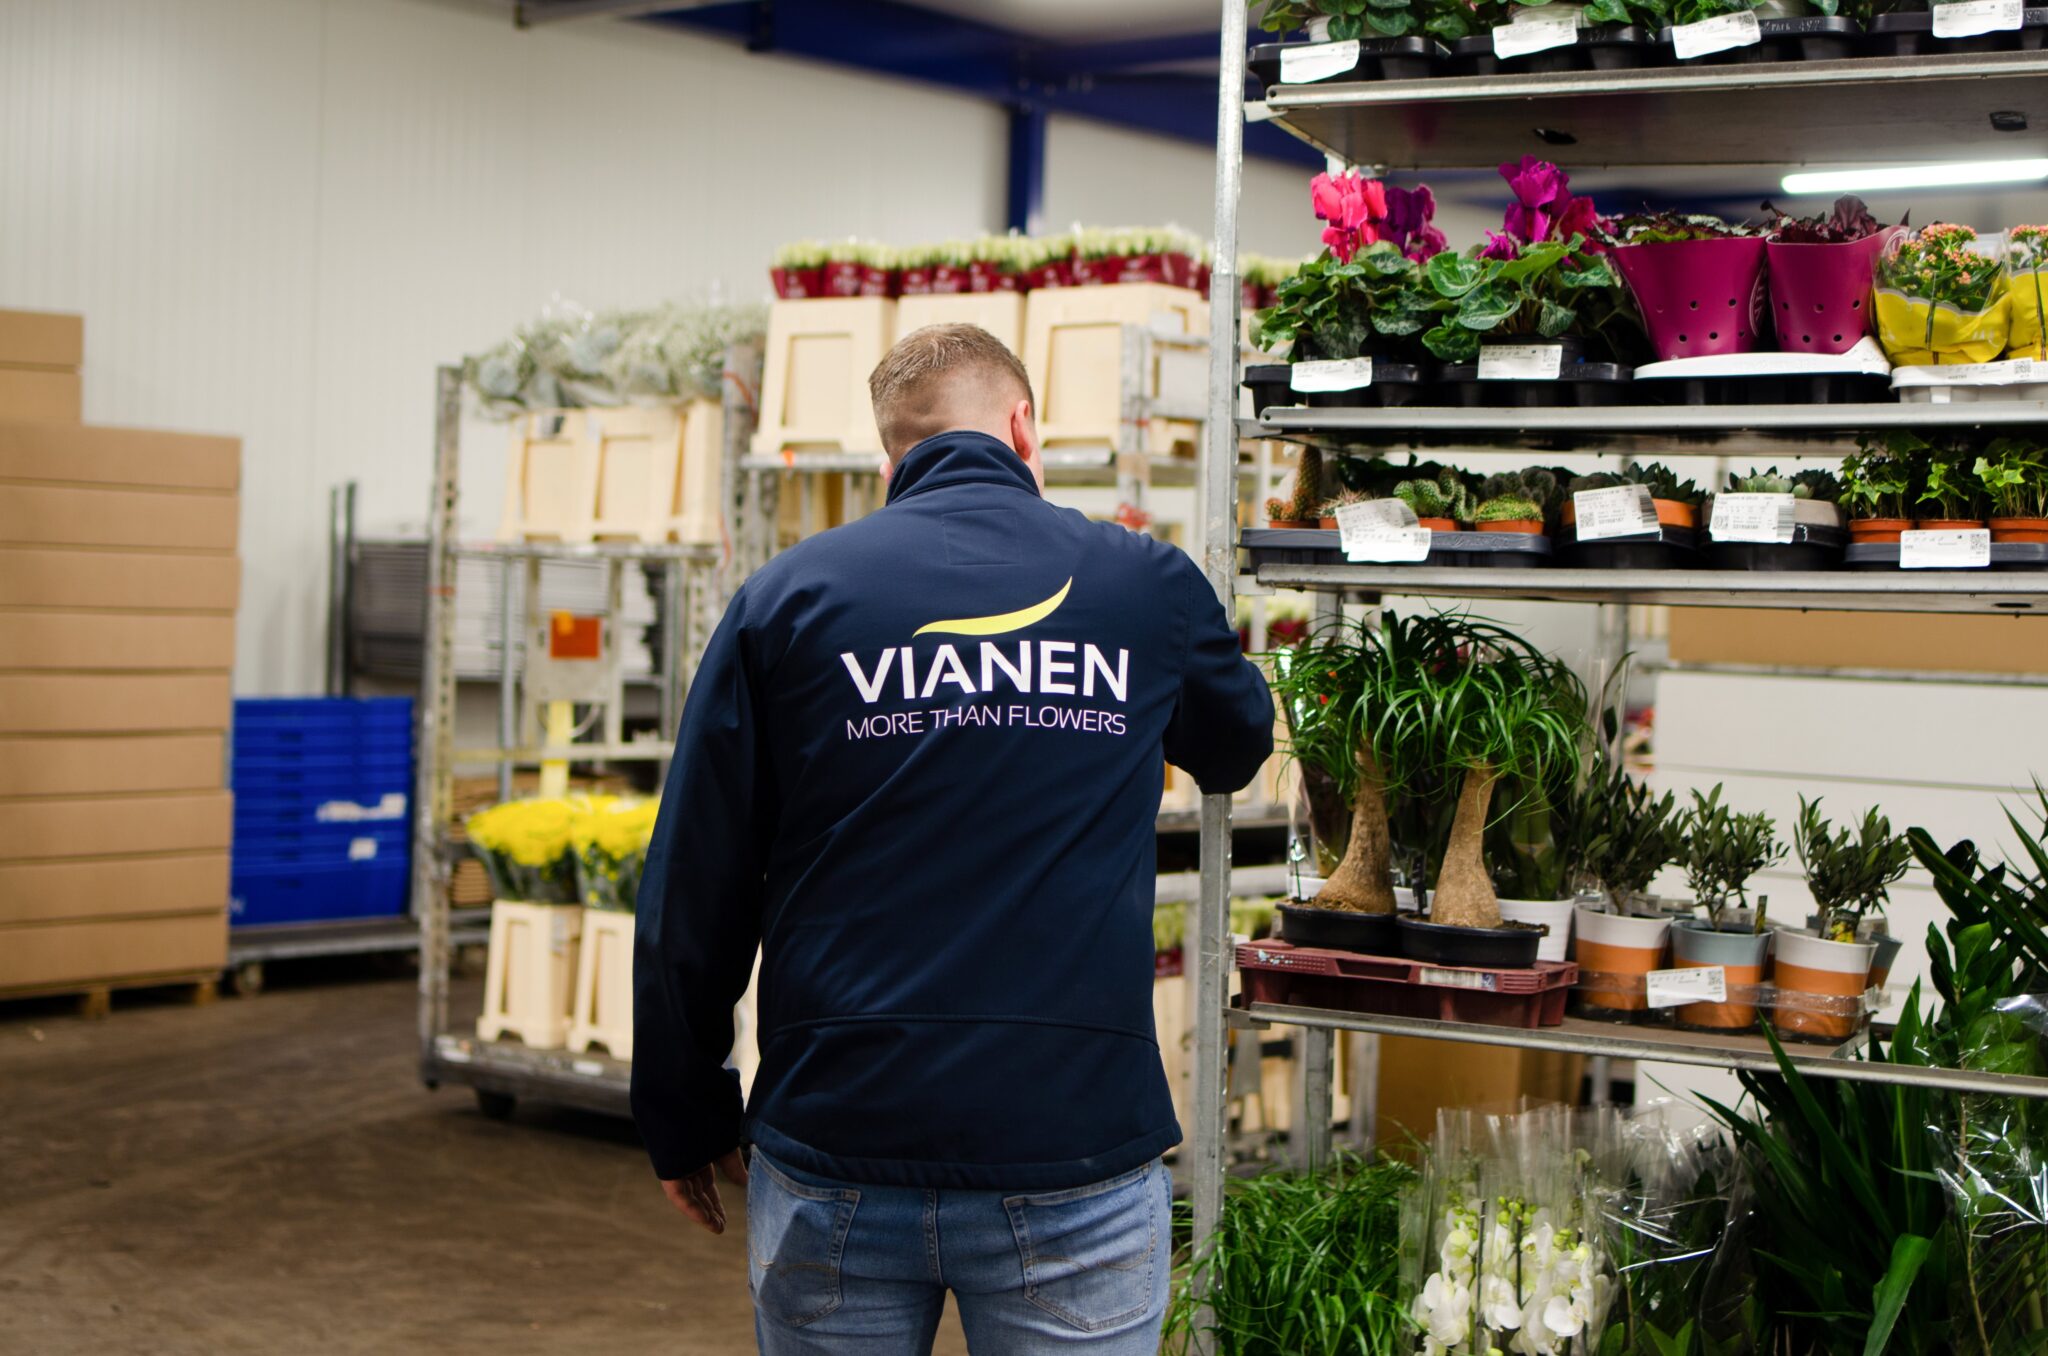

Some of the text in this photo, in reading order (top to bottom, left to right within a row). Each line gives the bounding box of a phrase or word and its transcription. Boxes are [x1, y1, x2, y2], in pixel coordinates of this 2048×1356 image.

[841, 640, 1129, 704] VIANEN
[847, 705, 1126, 740] MORE THAN FLOWERS
